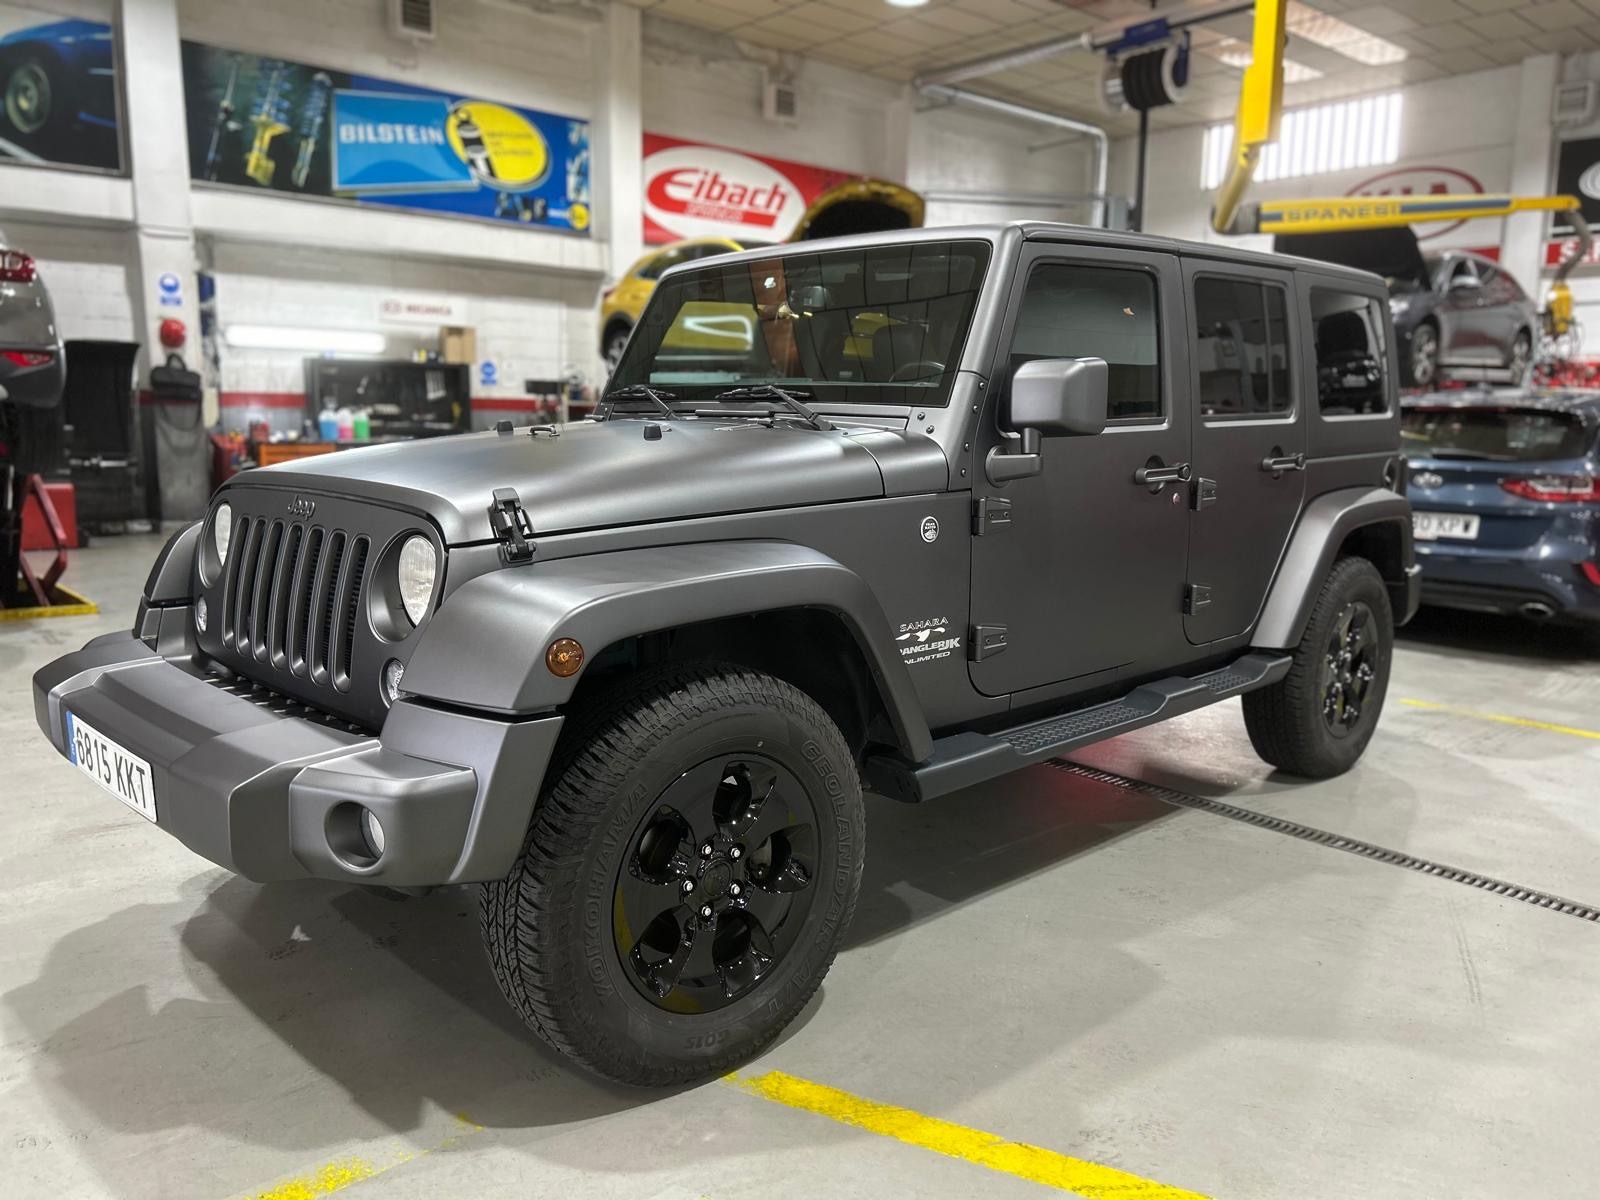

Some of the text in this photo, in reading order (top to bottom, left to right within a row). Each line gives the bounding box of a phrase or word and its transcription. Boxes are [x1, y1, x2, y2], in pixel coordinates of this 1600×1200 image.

[339, 122, 445, 145] BILSTEIN
[647, 167, 787, 220] Eibach
[1287, 203, 1398, 222] SPANESI
[288, 494, 315, 520] Jeep
[899, 616, 949, 632] SAHARA
[899, 640, 946, 655] ANGLER
[904, 651, 950, 664] NLIMITED
[76, 726, 146, 809] 6815 KKT
[802, 739, 851, 952] GEOLANDAR
[585, 783, 649, 1004] YOKOHAMA
